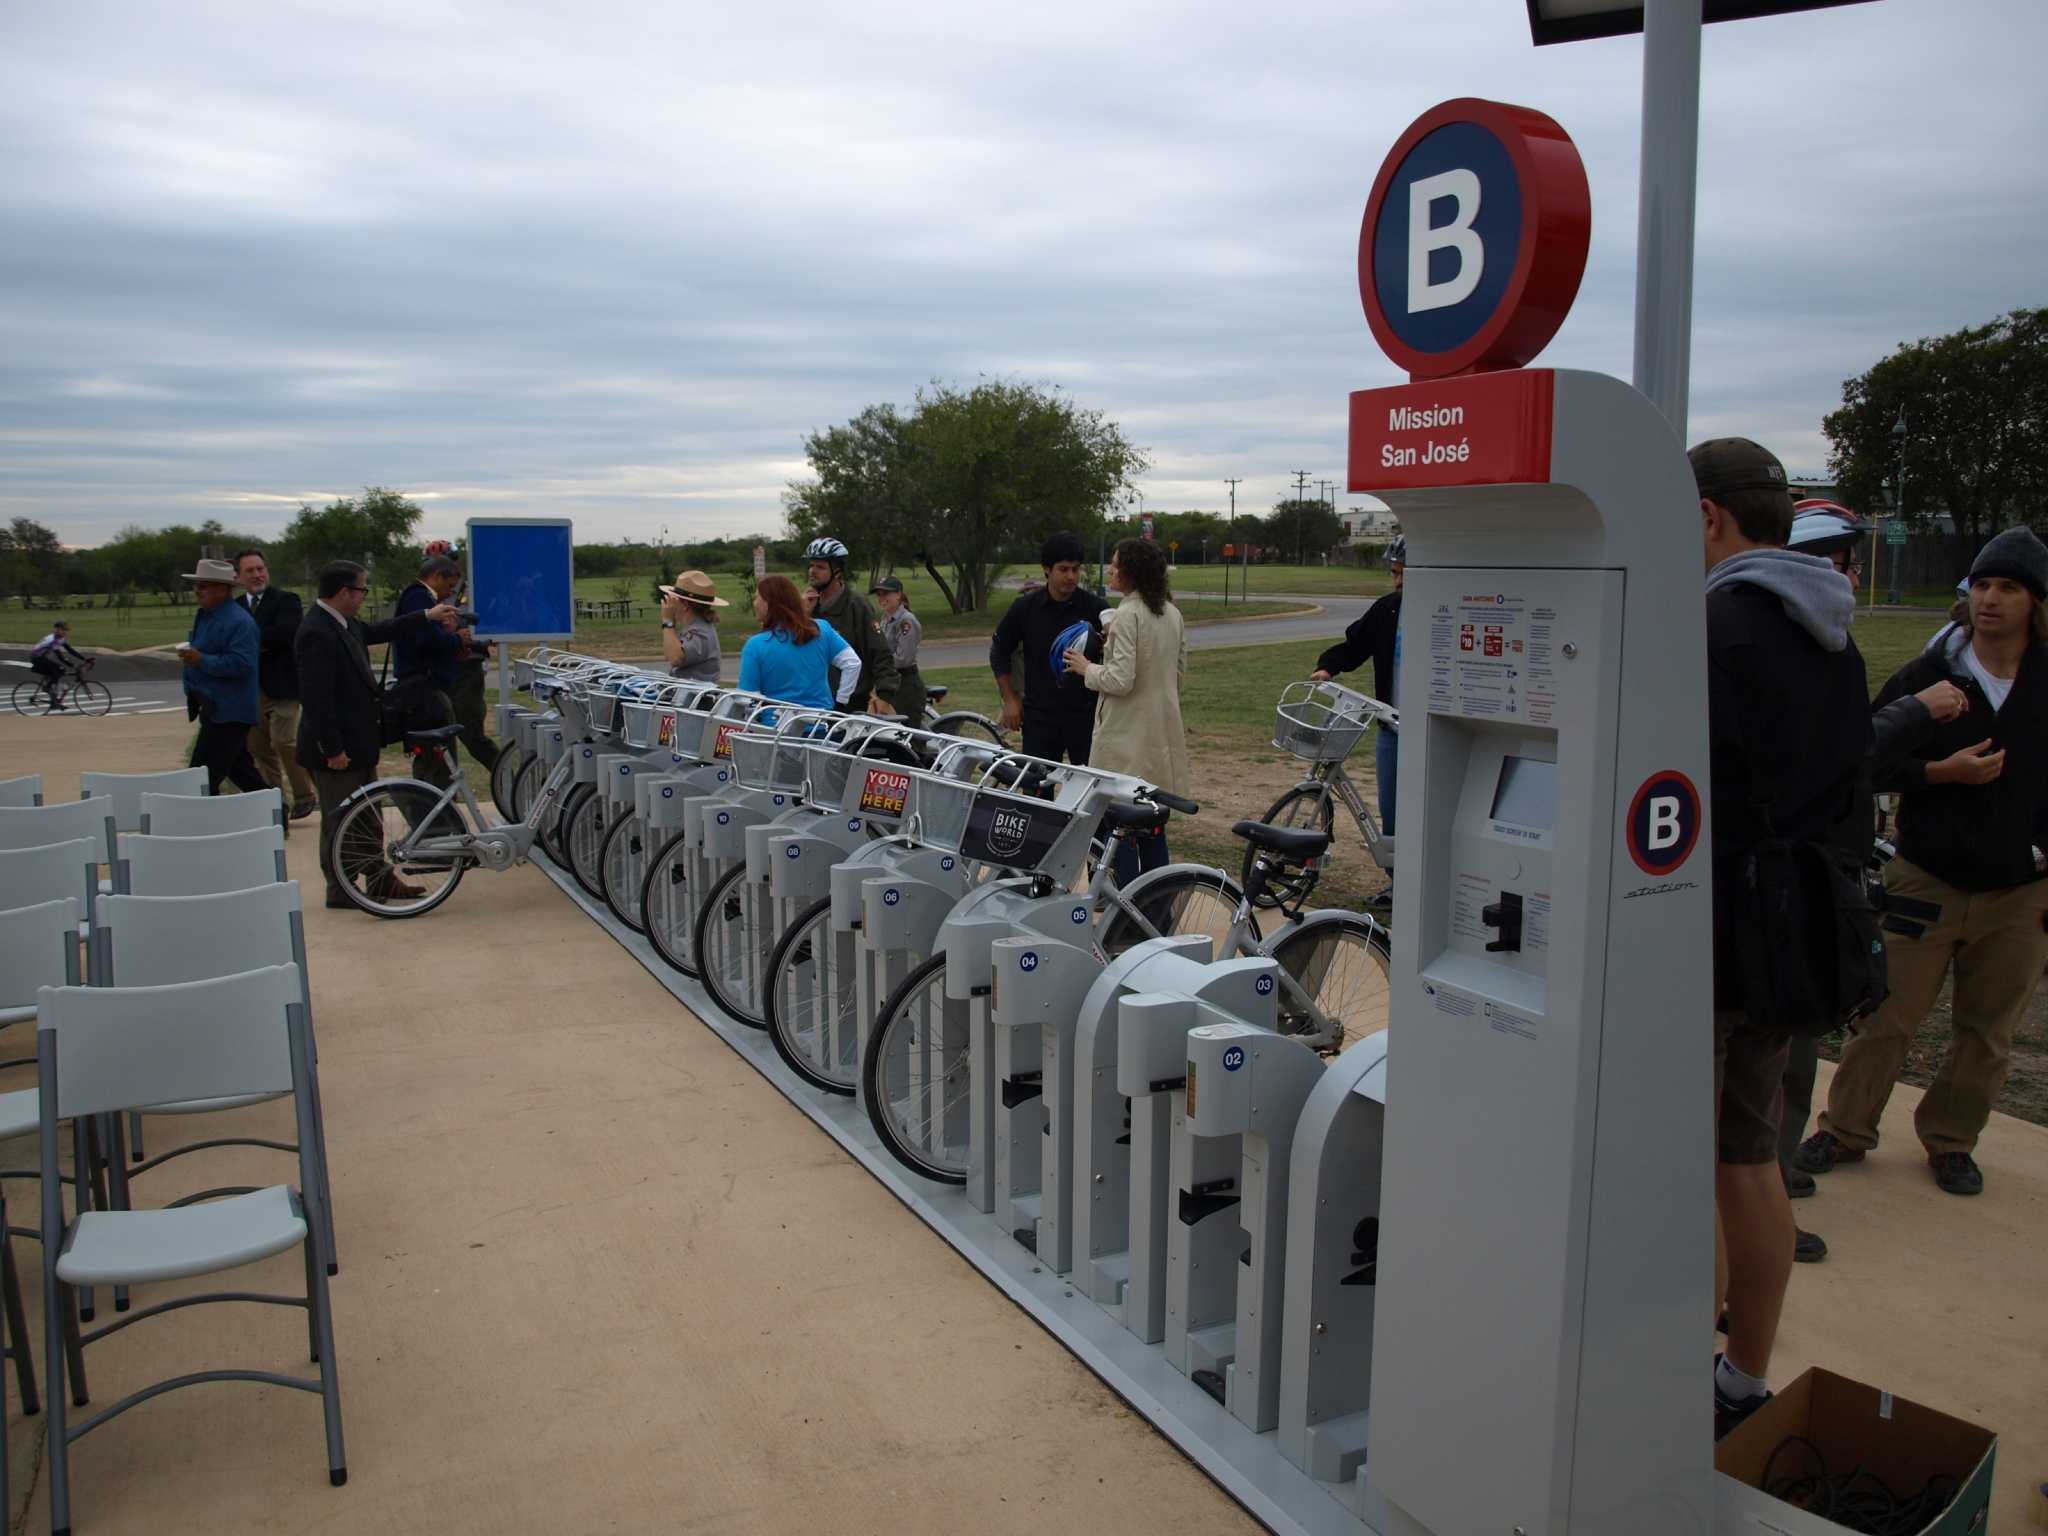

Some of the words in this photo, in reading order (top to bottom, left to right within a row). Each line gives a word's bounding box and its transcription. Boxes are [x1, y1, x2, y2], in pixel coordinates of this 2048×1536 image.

[1408, 168, 1485, 314] B
[1388, 404, 1465, 432] Mission
[1381, 443, 1417, 469] San
[1421, 437, 1471, 465] José
[869, 771, 909, 790] YOUR
[865, 784, 906, 800] LOGO
[862, 793, 904, 812] HERE
[849, 821, 860, 829] 09
[995, 813, 1027, 832] BIKE
[1648, 796, 1681, 850] B
[994, 826, 1023, 839] WORLD
[788, 847, 799, 856] 08
[942, 859, 953, 868] 07
[1624, 880, 1699, 899] station
[885, 892, 897, 902] 06
[1073, 911, 1086, 921] 05
[1021, 956, 1035, 967] 04
[1257, 979, 1271, 990] 03
[1225, 1052, 1241, 1065] 02
